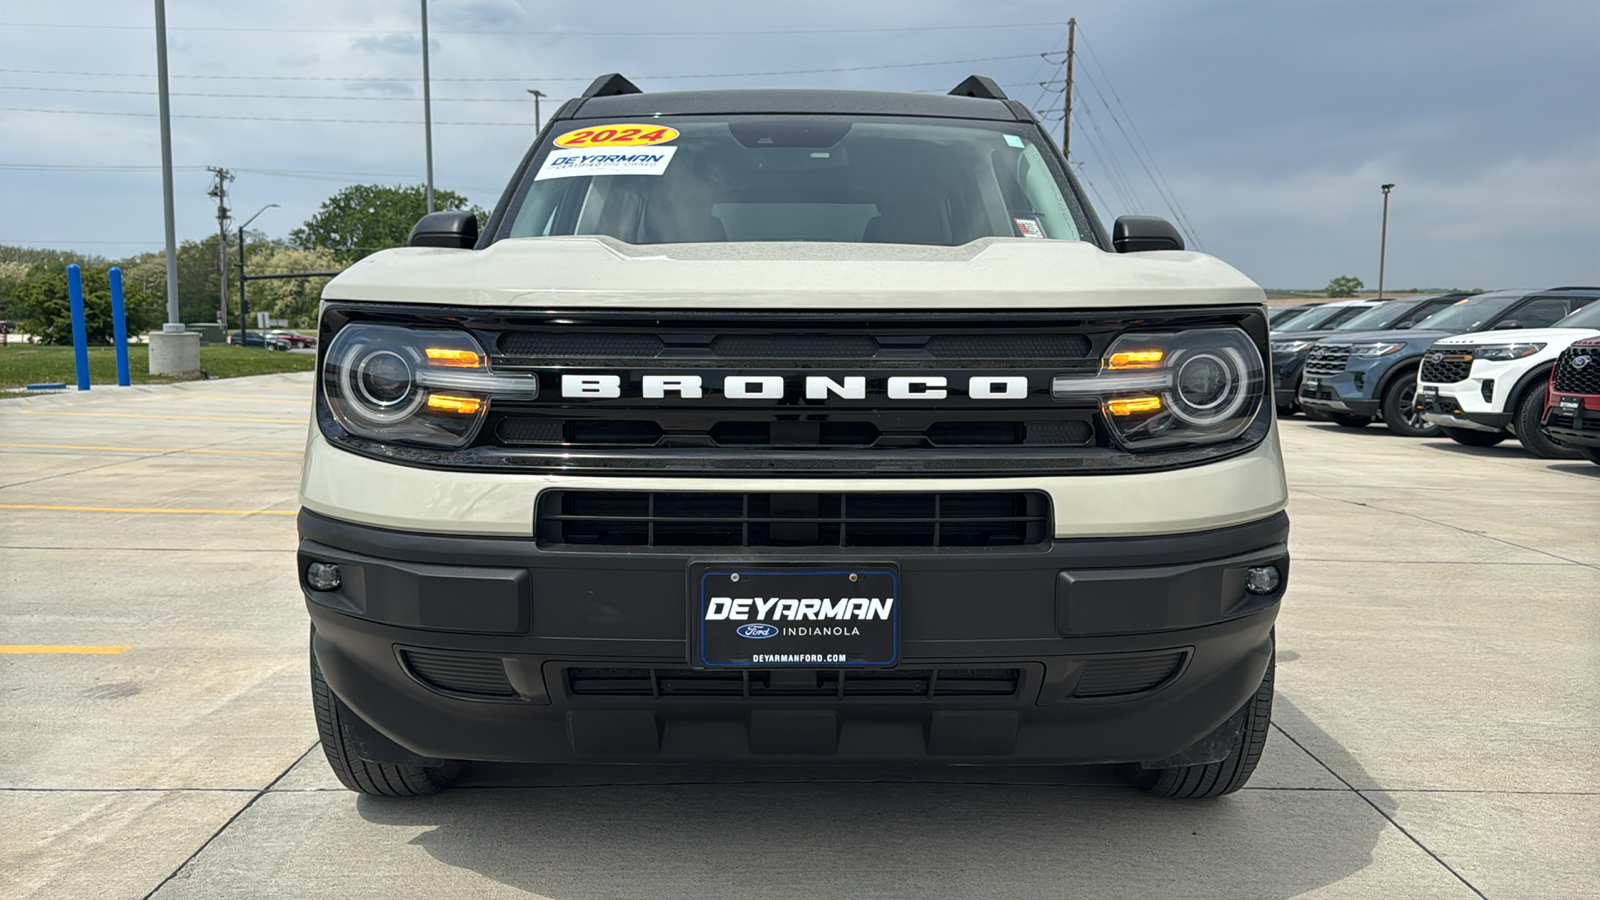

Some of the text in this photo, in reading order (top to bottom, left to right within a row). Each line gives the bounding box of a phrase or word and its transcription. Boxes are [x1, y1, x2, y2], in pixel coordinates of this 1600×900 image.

[563, 128, 668, 145] 2024
[550, 154, 665, 166] DEYARMAN
[562, 375, 1028, 399] BRONCO
[705, 597, 894, 620] DEYARMAN
[744, 625, 860, 637] Ford INDIANOLA
[753, 654, 846, 662] DEYARMANFORD.COM
